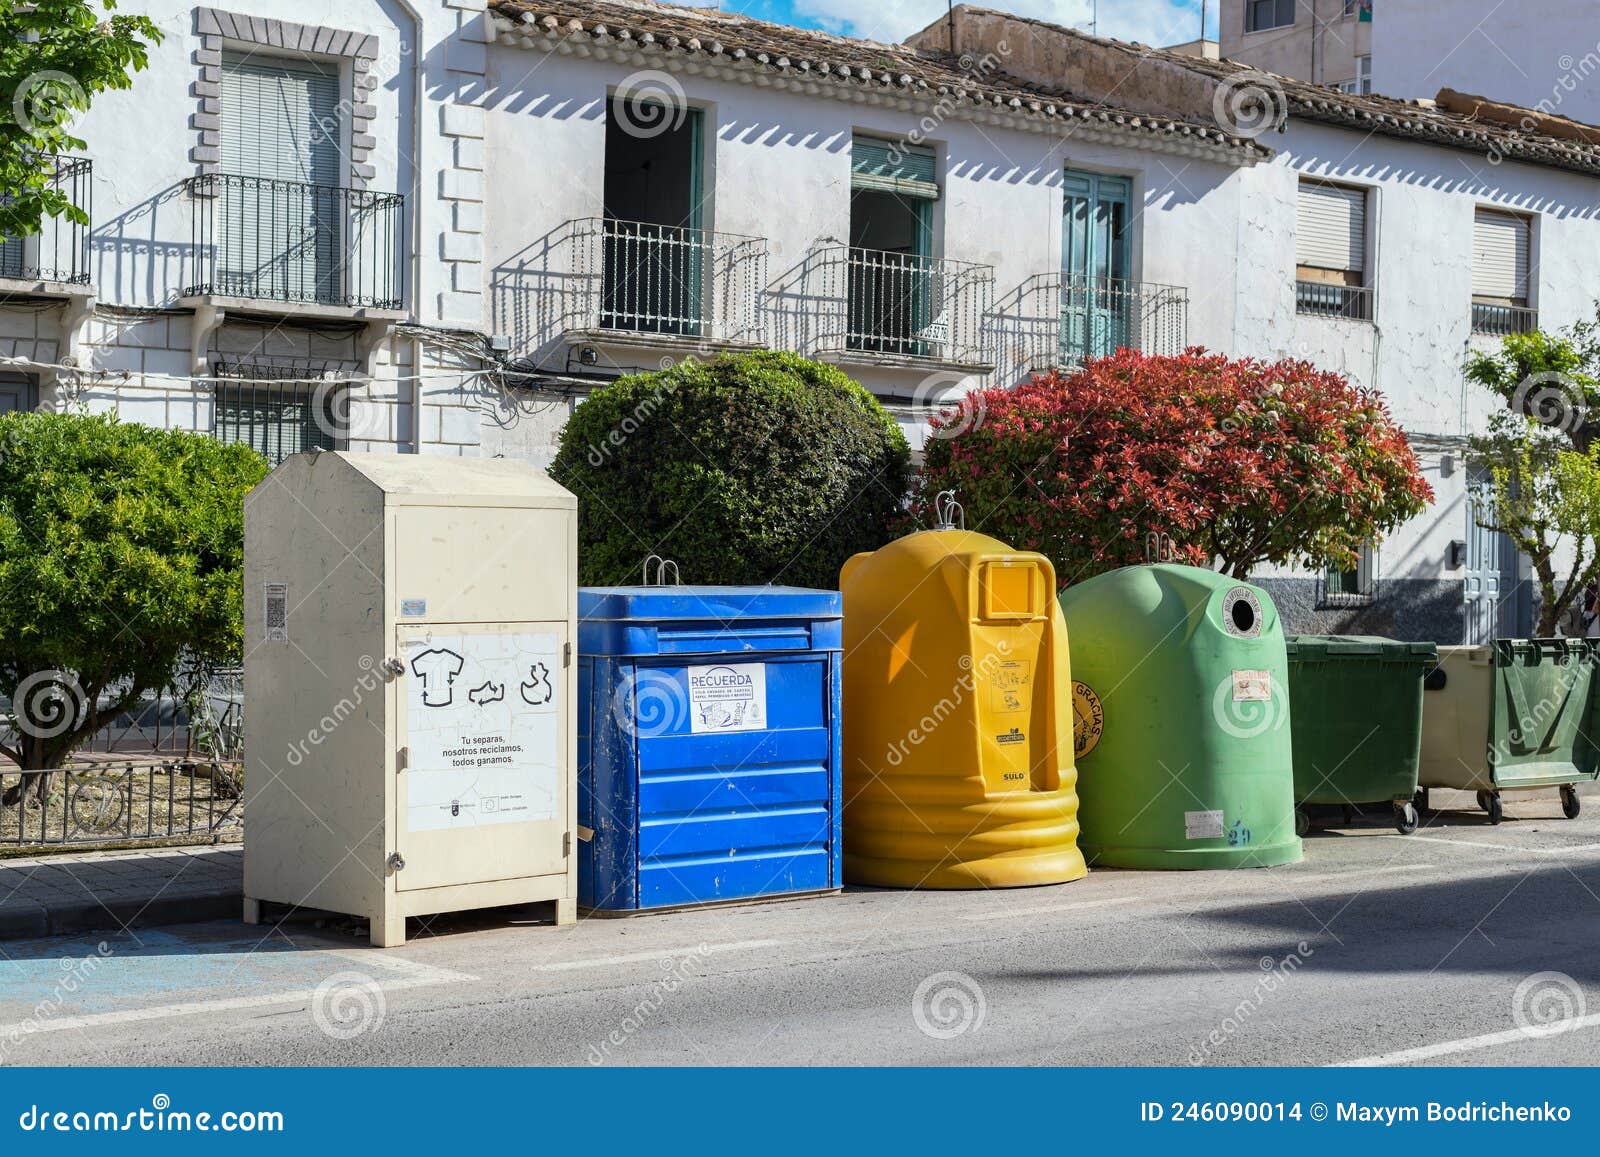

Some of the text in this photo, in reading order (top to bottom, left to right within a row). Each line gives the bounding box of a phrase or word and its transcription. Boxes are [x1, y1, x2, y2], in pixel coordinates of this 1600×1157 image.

[691, 674, 753, 687] RECUERDA
[1076, 684, 1102, 735] GRACIAS
[461, 735, 506, 746] Tu separas,
[442, 745, 524, 757] nosotros reciclamos,
[452, 755, 514, 767] todos ganamos.
[1003, 773, 1025, 781] SULO
